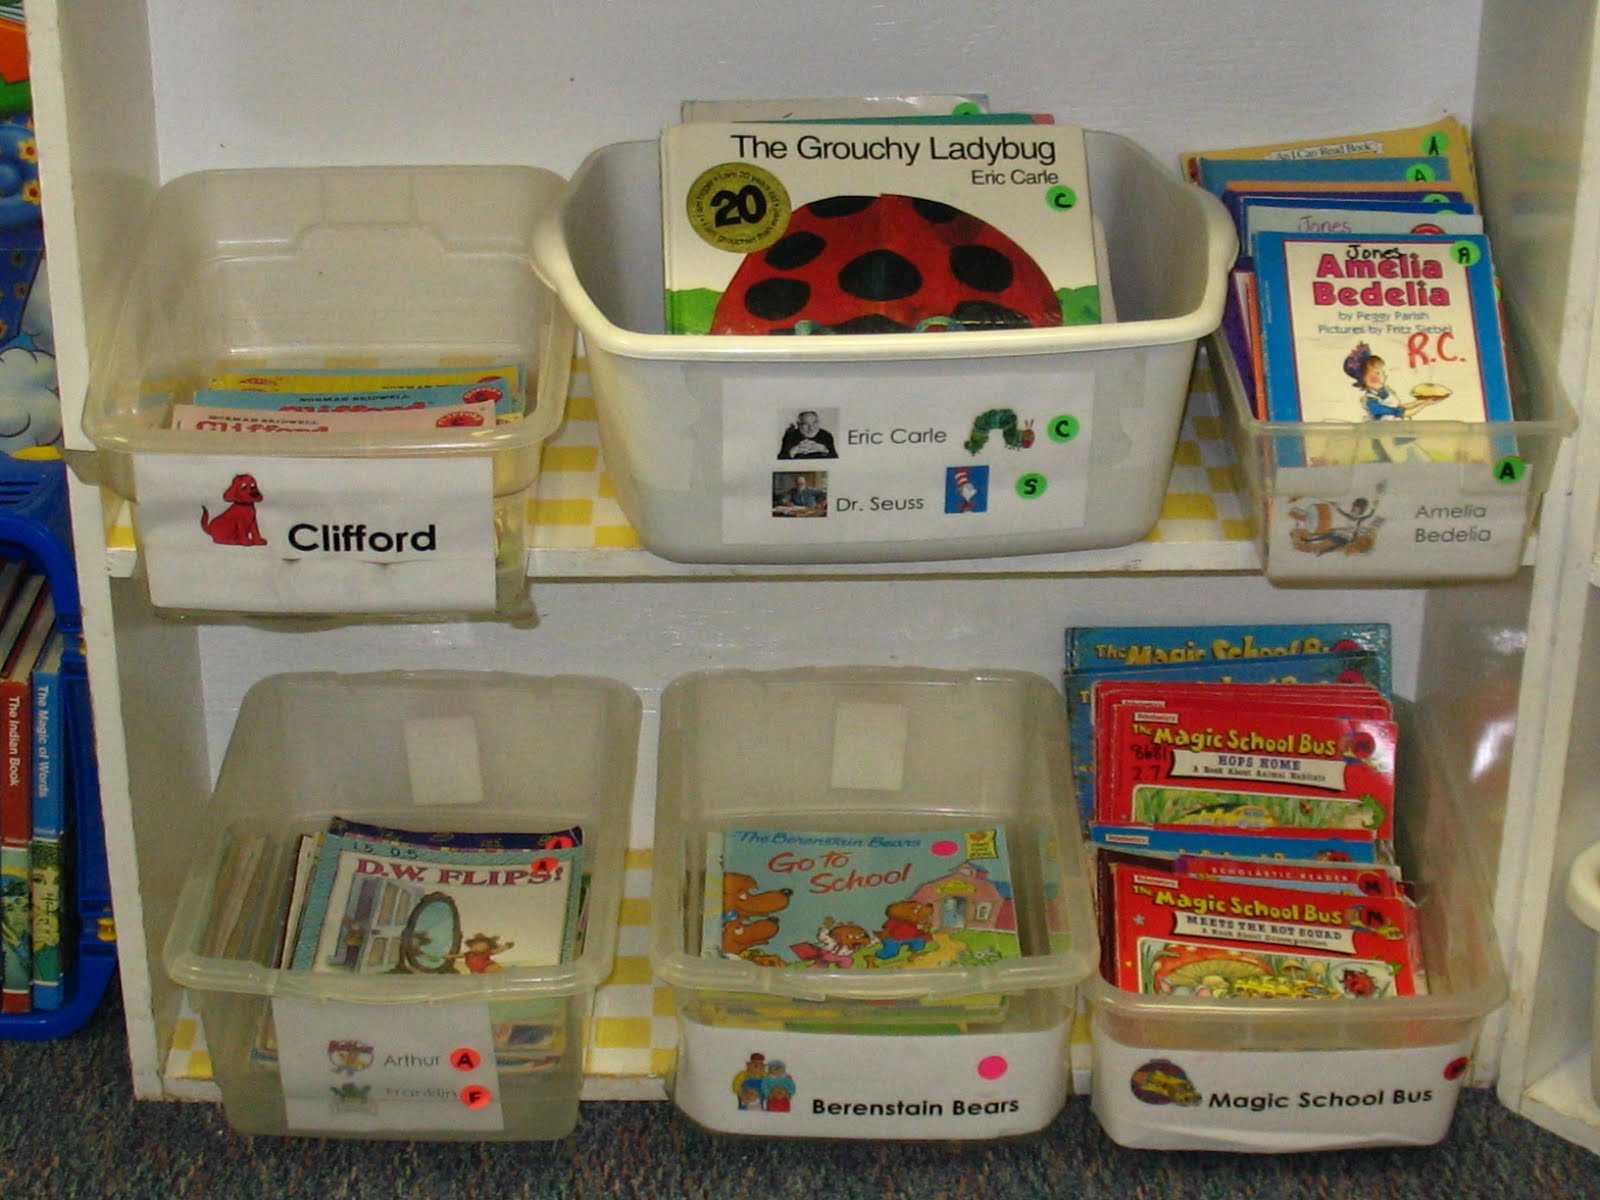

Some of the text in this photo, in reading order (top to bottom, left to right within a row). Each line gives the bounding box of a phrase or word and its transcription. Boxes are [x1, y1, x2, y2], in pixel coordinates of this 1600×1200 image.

[731, 134, 1056, 166] The Grouchy Ladybug
[971, 168, 1058, 185] Eric Carle
[710, 184, 767, 228] 20
[1055, 191, 1072, 209] C
[1346, 244, 1404, 261] Jones
[1316, 253, 1444, 279] Amelia
[1312, 280, 1451, 307] Bedelia
[1338, 311, 1353, 321] by
[1318, 324, 1365, 334] Pictures
[1369, 324, 1383, 334] by
[847, 427, 947, 446] Eric Carle
[1055, 419, 1070, 438] C
[1498, 462, 1516, 480] A
[1023, 478, 1039, 495] S
[836, 495, 924, 512] Dr. Seuss
[1414, 505, 1487, 520] Amelia
[288, 523, 437, 553] Clifford
[1414, 528, 1492, 544] Bedelia
[9, 696, 21, 787] The Indian Book
[37, 685, 51, 799] The Magic of Words
[1133, 723, 1154, 736] The
[1153, 728, 1224, 753] Magic
[1227, 728, 1295, 753] School
[1297, 734, 1336, 756] Bus
[1217, 755, 1301, 771] HOPS HOME
[735, 830, 767, 843] The
[867, 835, 922, 849] Bears
[767, 852, 815, 873] Go
[809, 862, 912, 895] School
[1133, 885, 1343, 925] The Magic School Bus
[1186, 915, 1234, 930] MEETS
[1239, 920, 1267, 932] THE
[1300, 926, 1343, 941] SQUAD
[384, 1054, 442, 1068] Arthur
[457, 1052, 476, 1069] A
[812, 1097, 1020, 1116] Berenstain Bears
[1208, 1088, 1433, 1112] Magic School Bus
